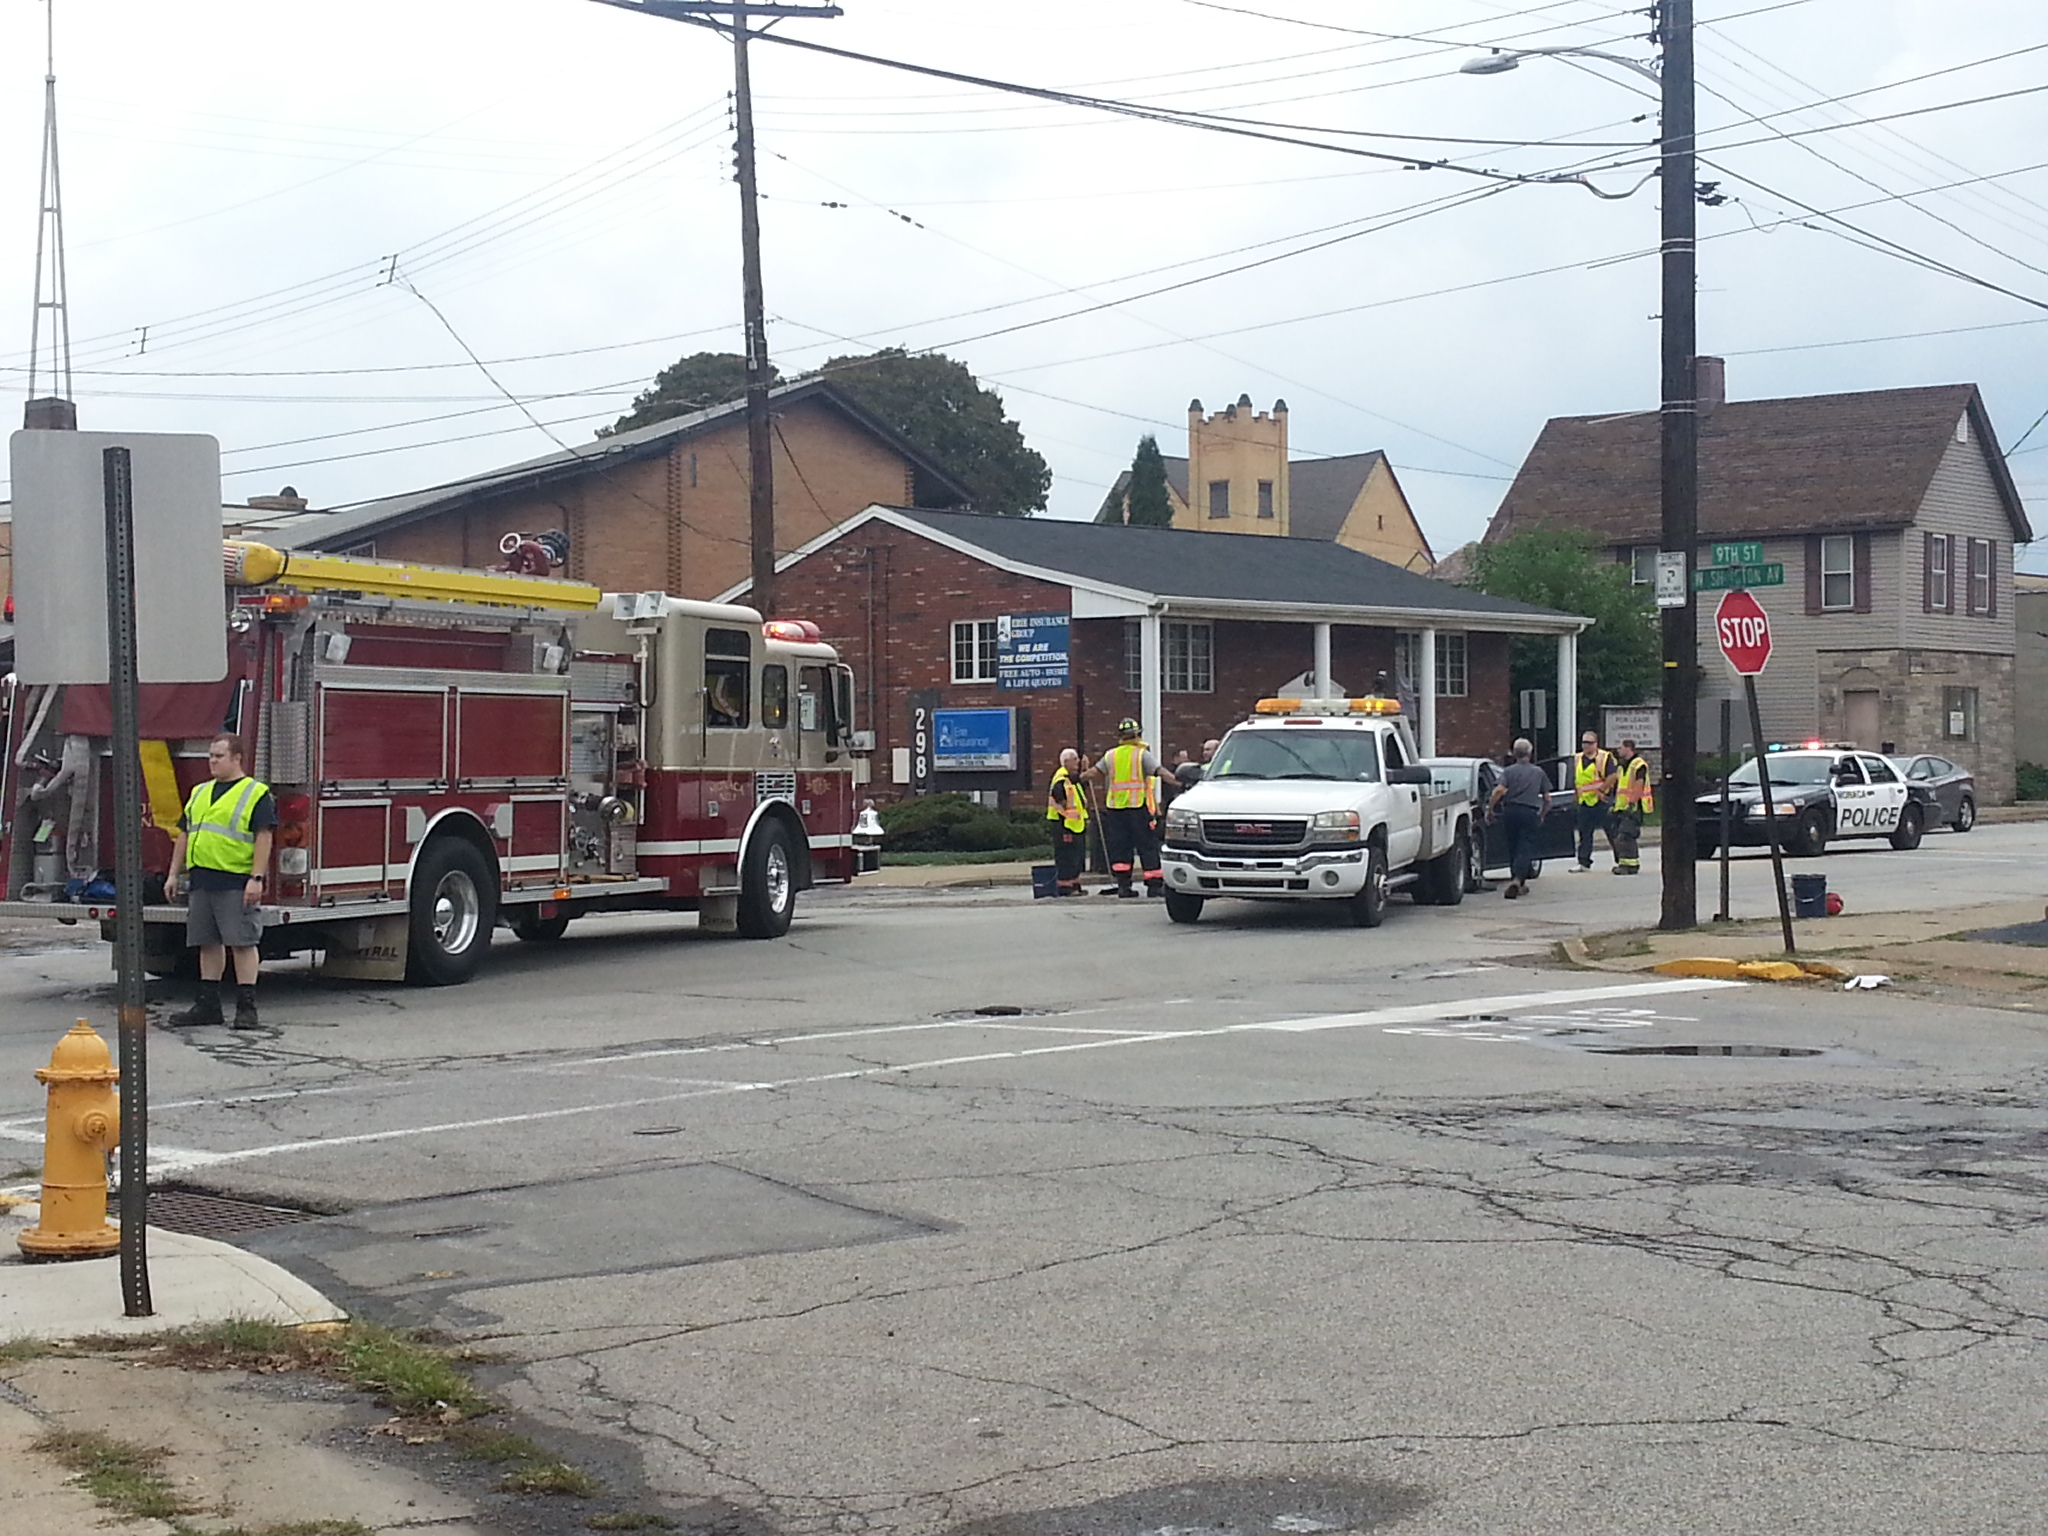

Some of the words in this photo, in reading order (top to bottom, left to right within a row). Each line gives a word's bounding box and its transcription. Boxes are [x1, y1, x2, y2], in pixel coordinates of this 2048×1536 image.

[1716, 546, 1739, 562] 9TH
[1743, 545, 1757, 560] ST
[1695, 568, 1761, 588] WSHGTON
[1767, 565, 1780, 582] AV
[1720, 617, 1765, 648] STOP
[1018, 643, 1031, 652] WE
[1032, 643, 1049, 652] ARE
[999, 654, 1014, 663] THE
[999, 669, 1018, 678] FREE
[1020, 669, 1041, 677] AUTO
[1013, 679, 1030, 688] LIFE
[1031, 678, 1062, 688] QUOTES
[1840, 806, 1899, 827] POLICE
